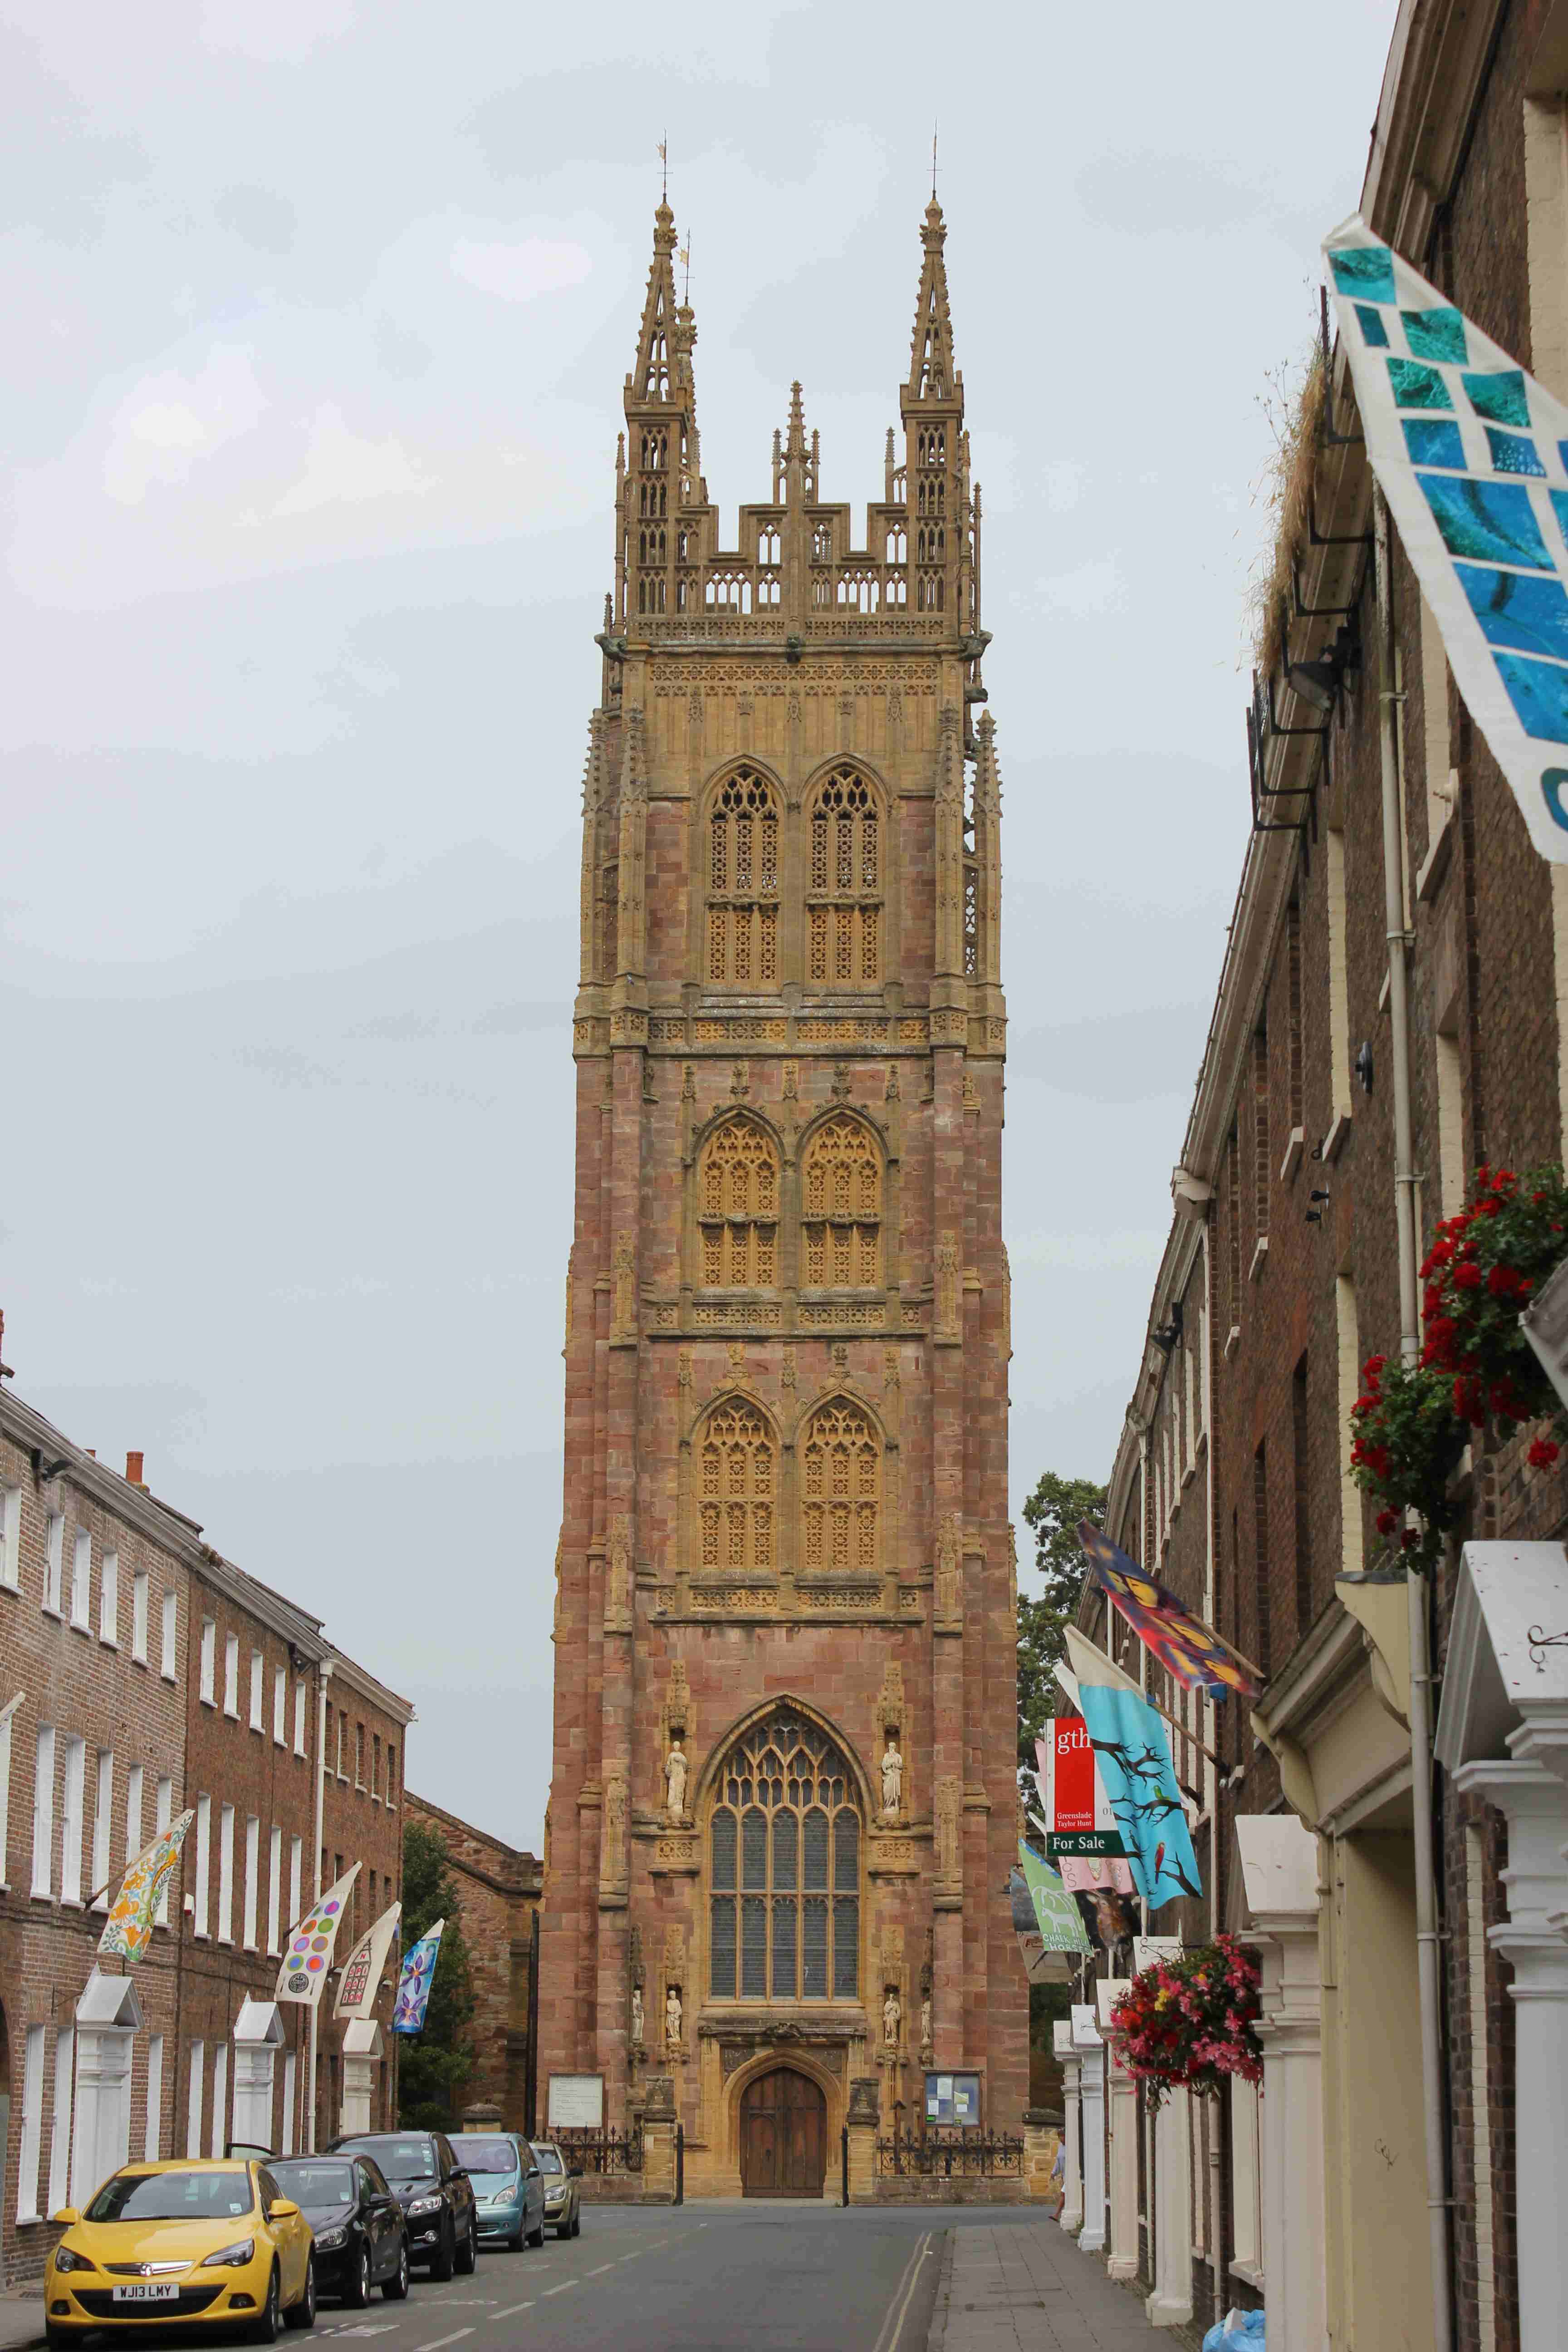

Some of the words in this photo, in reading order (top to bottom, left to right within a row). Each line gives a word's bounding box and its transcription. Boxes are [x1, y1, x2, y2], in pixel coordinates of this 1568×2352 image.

[1058, 1728, 1091, 1754] gth
[1053, 1837, 1074, 1849] For
[1078, 1836, 1105, 1849] Sale
[1043, 1933, 1070, 1944] CHALK
[121, 2287, 145, 2298] WJ13
[149, 2285, 171, 2296] LMY
